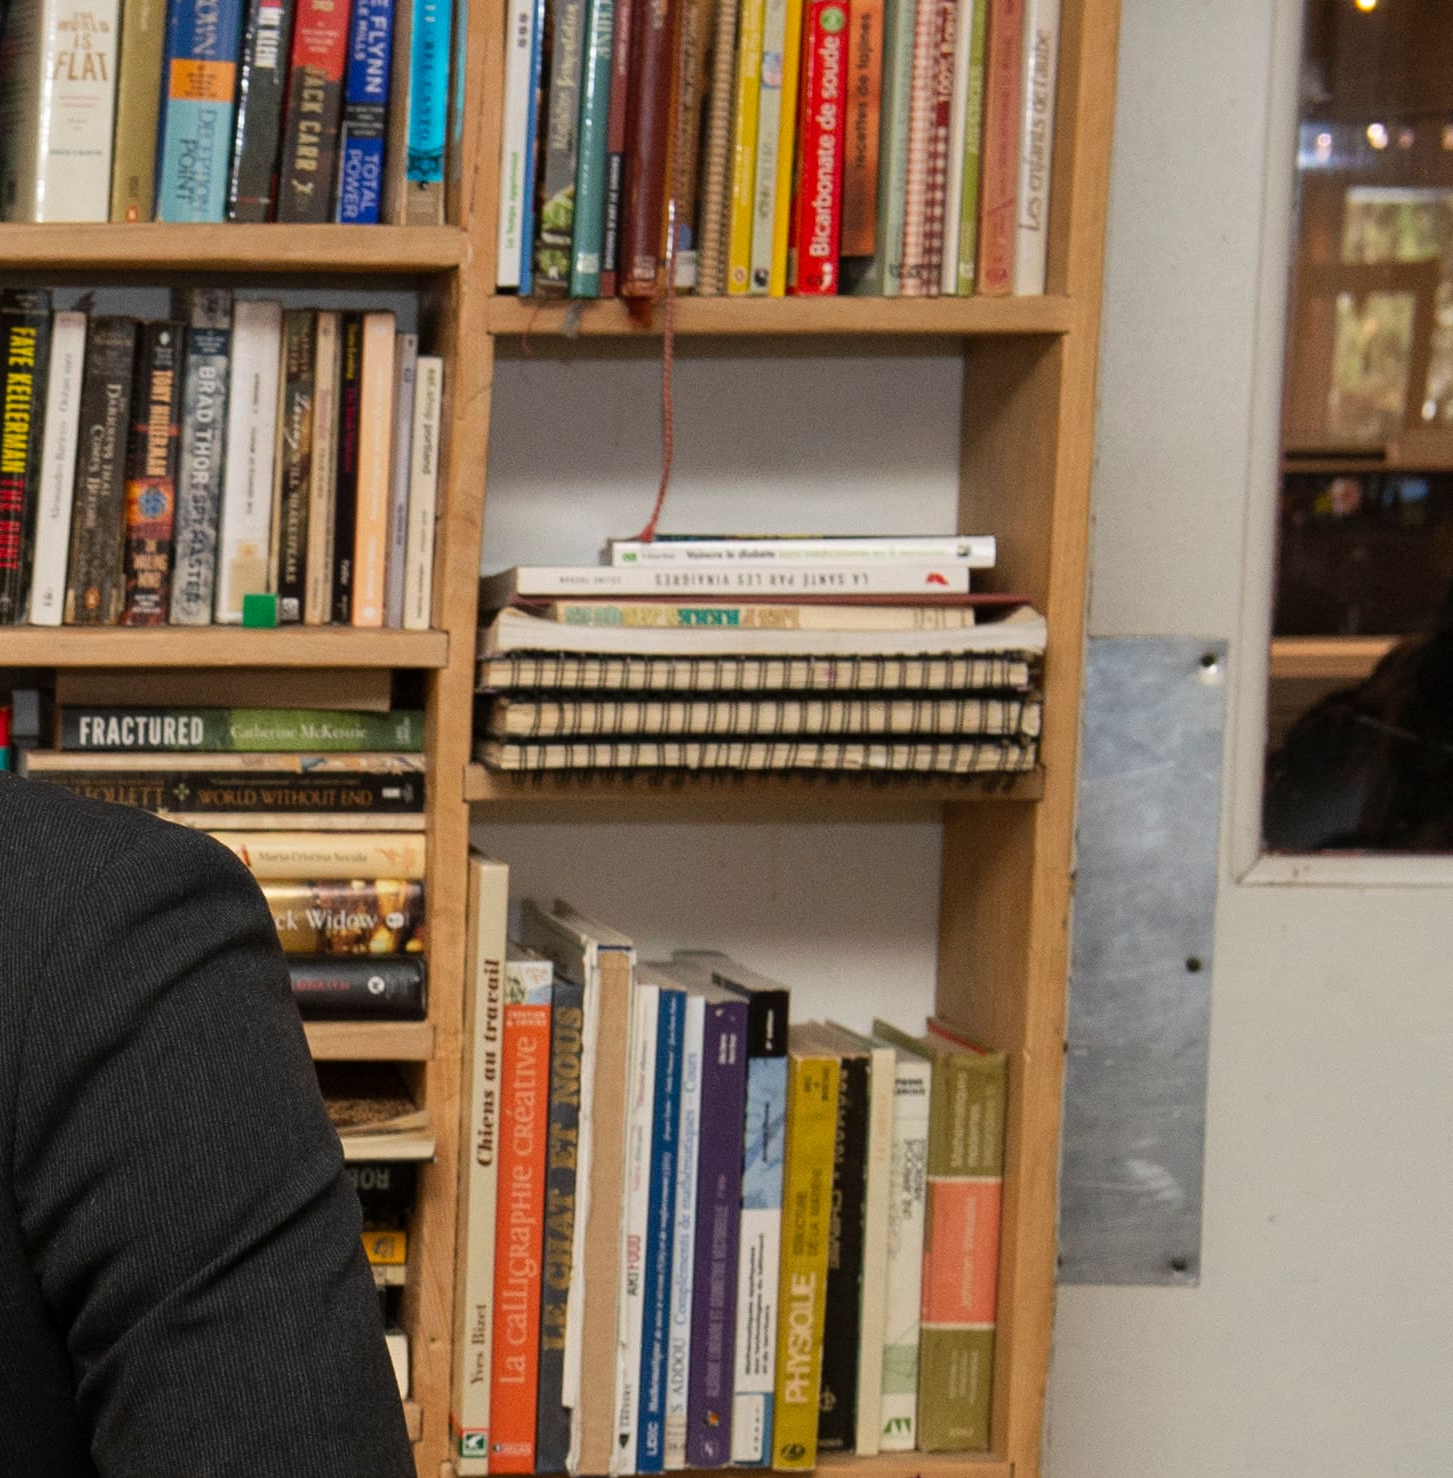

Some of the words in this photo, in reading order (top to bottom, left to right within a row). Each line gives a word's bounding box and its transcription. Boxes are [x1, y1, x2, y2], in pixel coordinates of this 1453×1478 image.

[364, 16, 388, 93] FLYNN
[817, 36, 842, 100] soude
[853, 73, 870, 94] de
[817, 104, 839, 130] de
[851, 98, 871, 168] recettes
[295, 121, 321, 170] CARR
[809, 135, 838, 256] Bicarbonate
[9, 327, 37, 366] FAYE
[150, 370, 173, 403] TONY
[197, 366, 216, 423] BRAD
[0, 372, 33, 473] KELLERMAN
[193, 429, 213, 485] THOR
[79, 717, 204, 745] FRACTURED
[308, 909, 378, 930] Widow
[478, 958, 500, 1043] travail
[481, 1049, 497, 1081] au
[555, 1006, 582, 1104] NOUS
[476, 1085, 495, 1167] Chiens
[552, 1123, 577, 1170] ET
[547, 1188, 575, 1289] CHAT
[470, 1303, 488, 1344] Bizet
[544, 1303, 571, 1350] LE
[785, 1274, 817, 1404] PHYSIQUE
[470, 1348, 488, 1384] Yves
